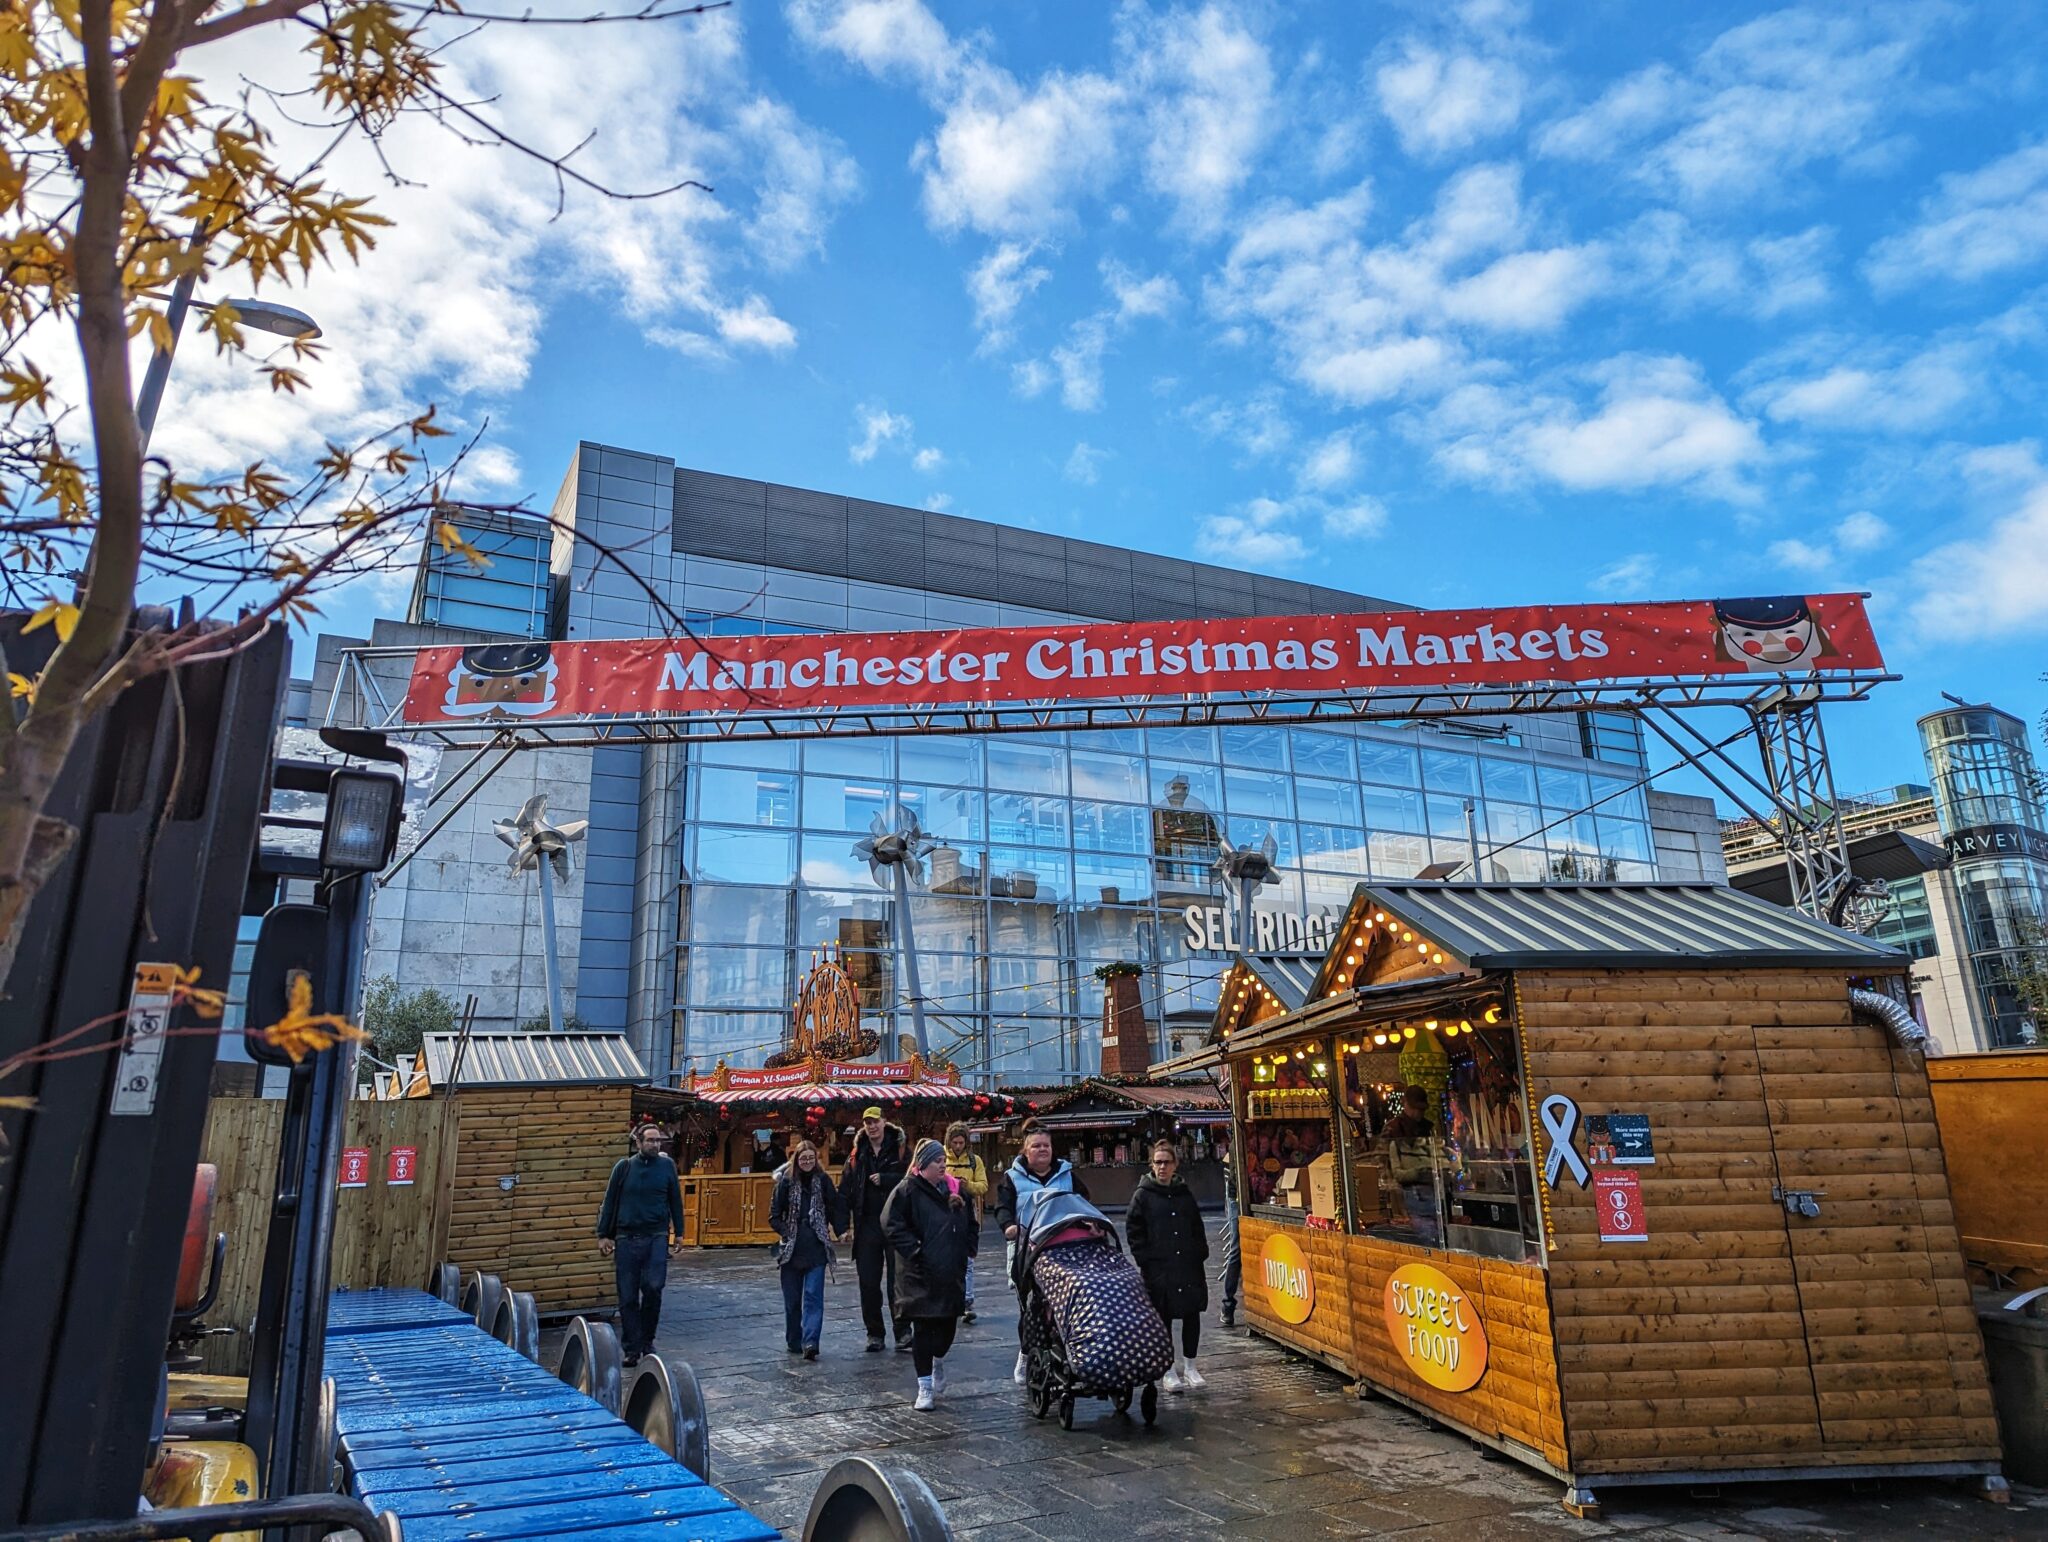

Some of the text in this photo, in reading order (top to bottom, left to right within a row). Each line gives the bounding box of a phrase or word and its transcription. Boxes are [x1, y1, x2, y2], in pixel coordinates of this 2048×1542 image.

[656, 623, 1609, 692] Manchester Christmas Markets
[1945, 833, 2018, 856] HARVEY
[1183, 904, 1341, 951] SELRIDGE
[730, 1074, 761, 1085] German
[762, 1070, 810, 1085] XL-Sausage
[832, 1066, 905, 1076] Bavarian Beer
[1264, 1258, 1308, 1300] INDIAN
[1392, 1280, 1470, 1333] STREET
[1407, 1323, 1459, 1372] FOOD
